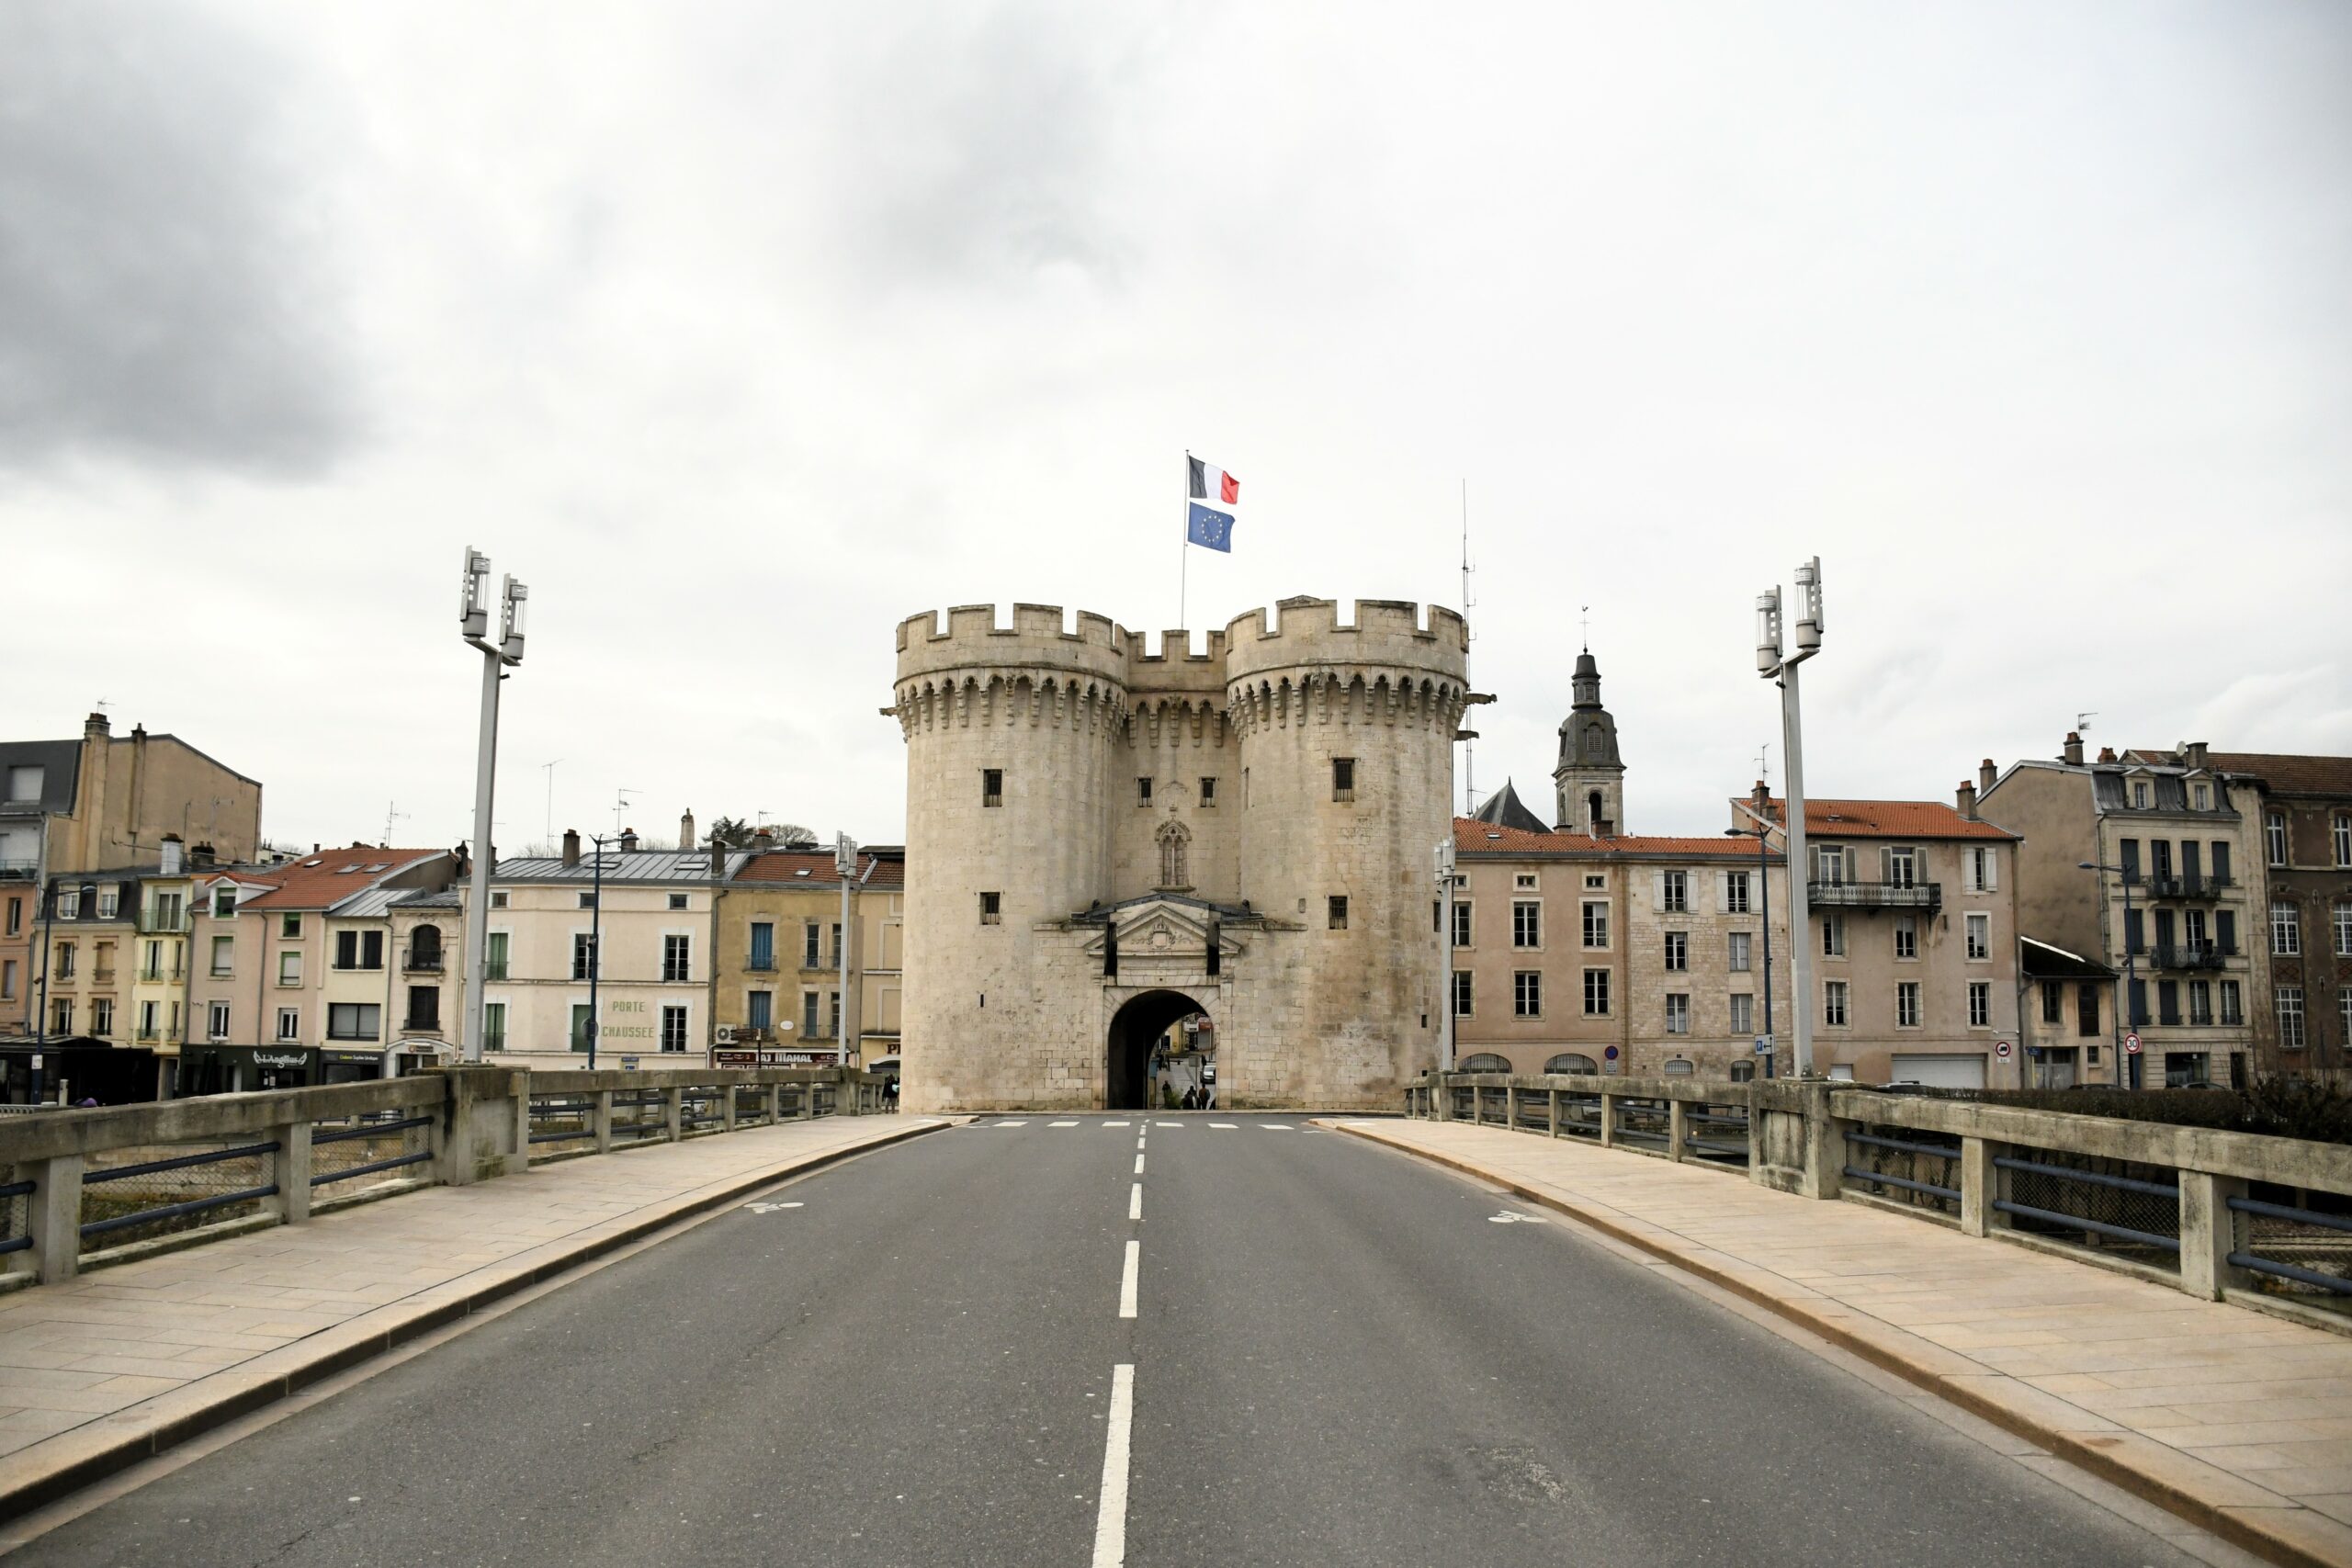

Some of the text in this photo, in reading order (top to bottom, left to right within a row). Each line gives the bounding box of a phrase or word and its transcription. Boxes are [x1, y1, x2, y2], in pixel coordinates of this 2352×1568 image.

[613, 1000, 645, 1012] PORTE
[603, 1026, 654, 1038] CHAUSSEE
[2128, 1039, 2137, 1047] 30
[755, 1053, 771, 1062] TAJ
[775, 1053, 813, 1063] MAHAL
